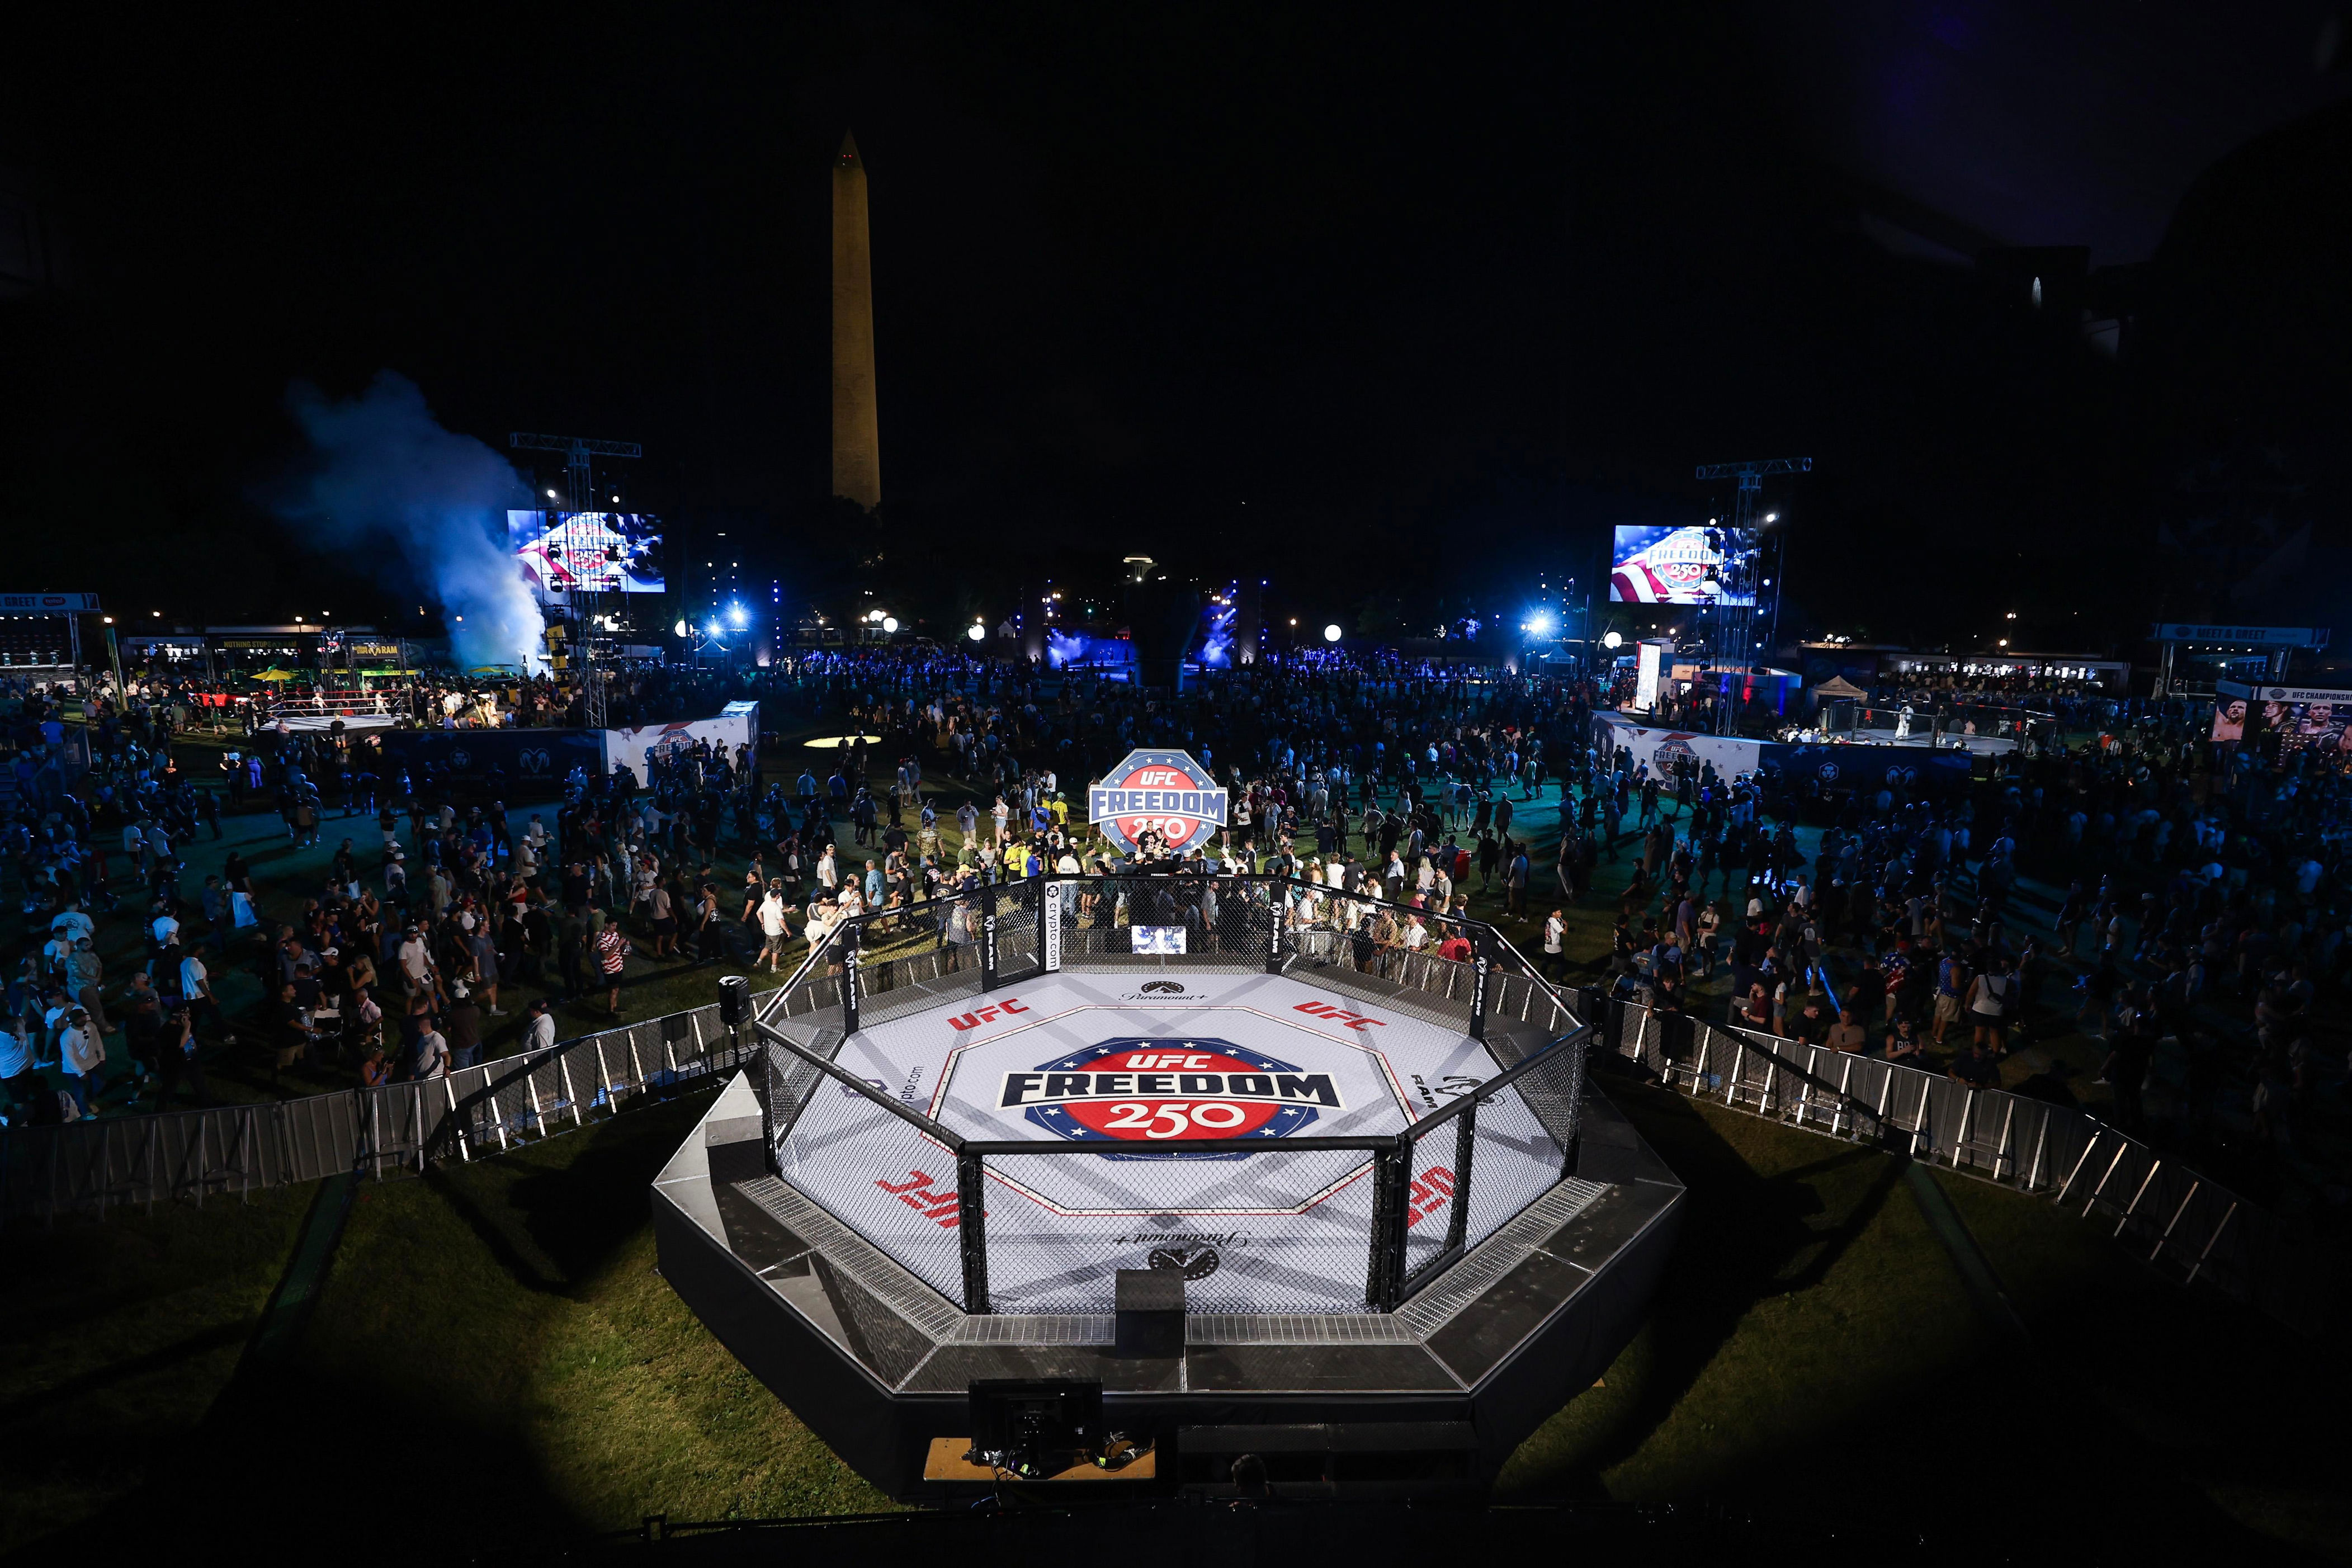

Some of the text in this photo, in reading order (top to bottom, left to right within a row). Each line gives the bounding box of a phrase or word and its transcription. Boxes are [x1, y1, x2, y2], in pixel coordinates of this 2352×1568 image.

[1650, 550, 1722, 565] FREEDOM
[1669, 564, 1701, 580] 250
[4, 597, 36, 607] GREET
[2197, 629, 2224, 639] MEET
[2225, 629, 2232, 639] &
[2235, 629, 2266, 640] GREET
[381, 645, 398, 654] RAM
[2306, 692, 2352, 701] CHAMPIONSHI
[653, 742, 693, 754] FREDO
[1140, 771, 1178, 786] UFC
[1092, 790, 1226, 825] FREEDOM
[1049, 903, 1057, 968] crypto.com
[1118, 992, 1208, 1001] Paramount+
[1475, 975, 1484, 1017] RAM
[947, 998, 1030, 1031] UFC
[1293, 1001, 1387, 1032] UFC
[1125, 1054, 1212, 1069] UFC
[899, 1066, 924, 1104] ypto.com
[1000, 1073, 1340, 1108] FREEDOM
[1411, 1074, 1439, 1108] RAM
[1103, 1103, 1246, 1139] 250
[1112, 1231, 1251, 1249] Paramount+
